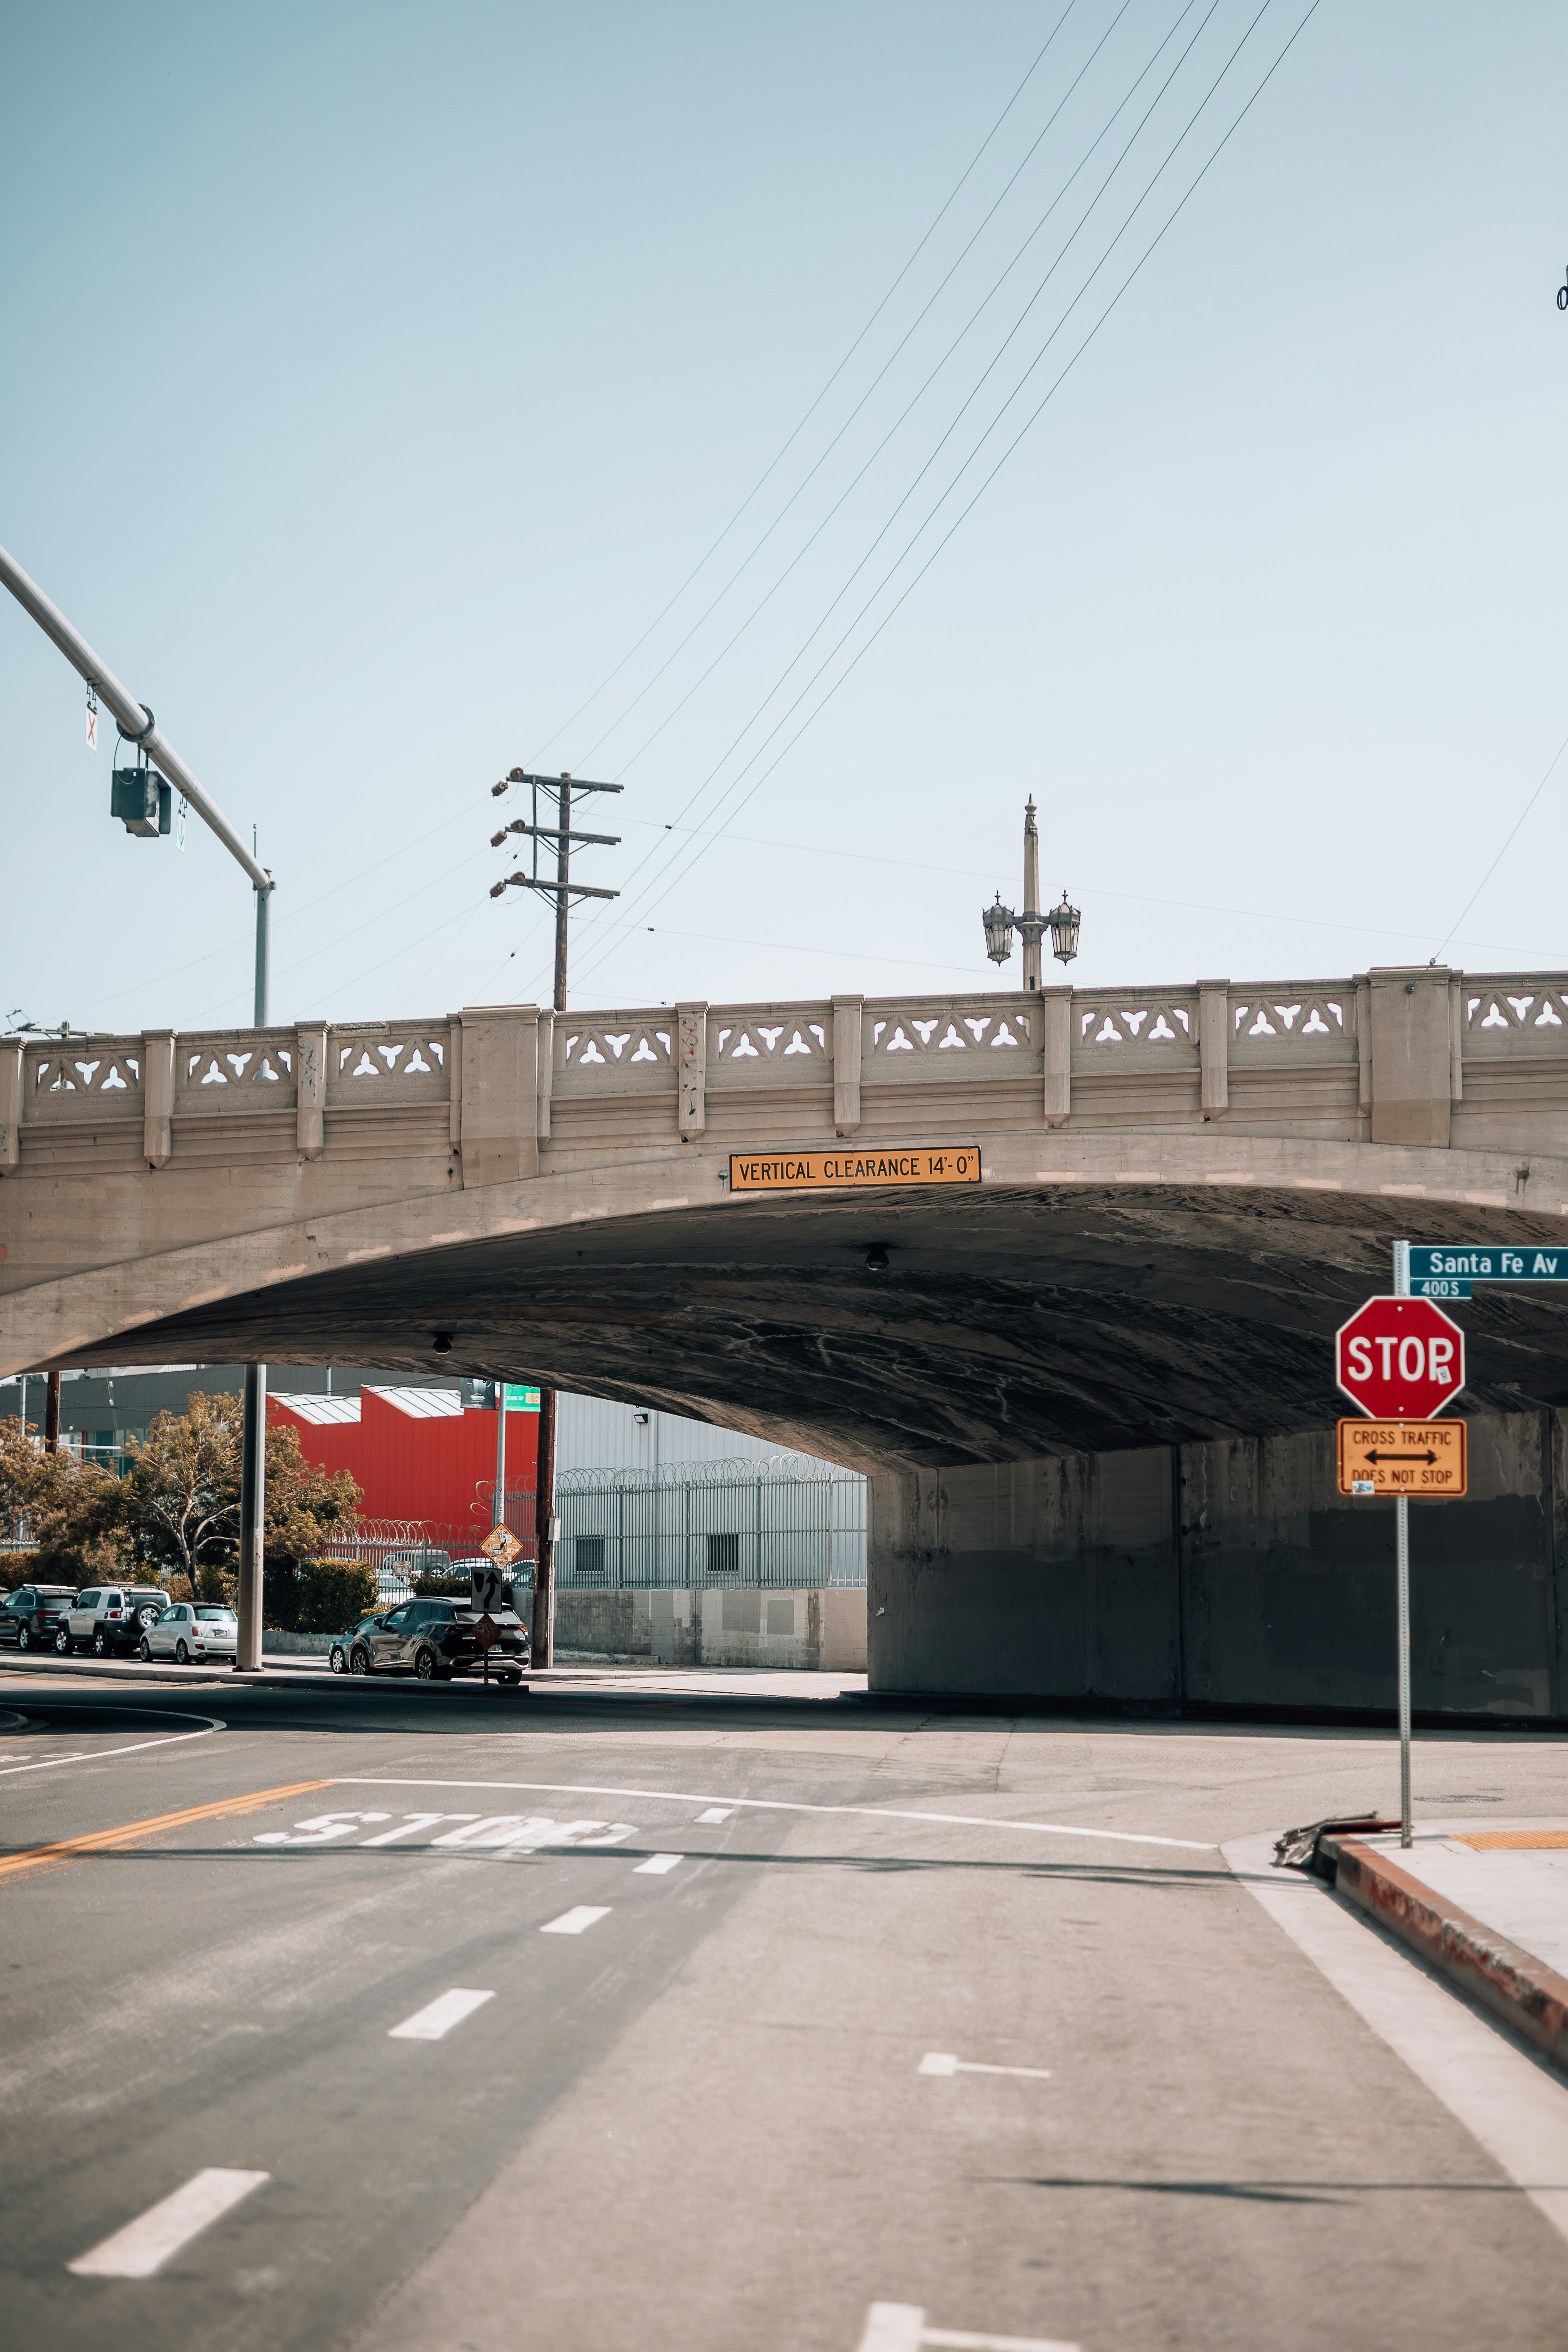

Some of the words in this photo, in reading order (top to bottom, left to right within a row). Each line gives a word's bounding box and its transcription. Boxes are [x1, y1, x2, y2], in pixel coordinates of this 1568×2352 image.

[739, 1161, 816, 1181] VERTICAL
[824, 1157, 920, 1178] CLEARANCE
[1430, 1252, 1492, 1273] Santa
[1501, 1253, 1524, 1273] Fe
[1532, 1253, 1558, 1273] Av
[1421, 1281, 1449, 1295] 400
[1450, 1281, 1459, 1295] S
[1347, 1336, 1454, 1381] STOP
[1353, 1431, 1395, 1445] CROSS
[1401, 1431, 1452, 1445] TRAFFIC
[1353, 1469, 1386, 1484] DOES
[1391, 1470, 1415, 1484] NOT
[1421, 1470, 1453, 1484] STOP
[252, 1811, 640, 1854] STOP
